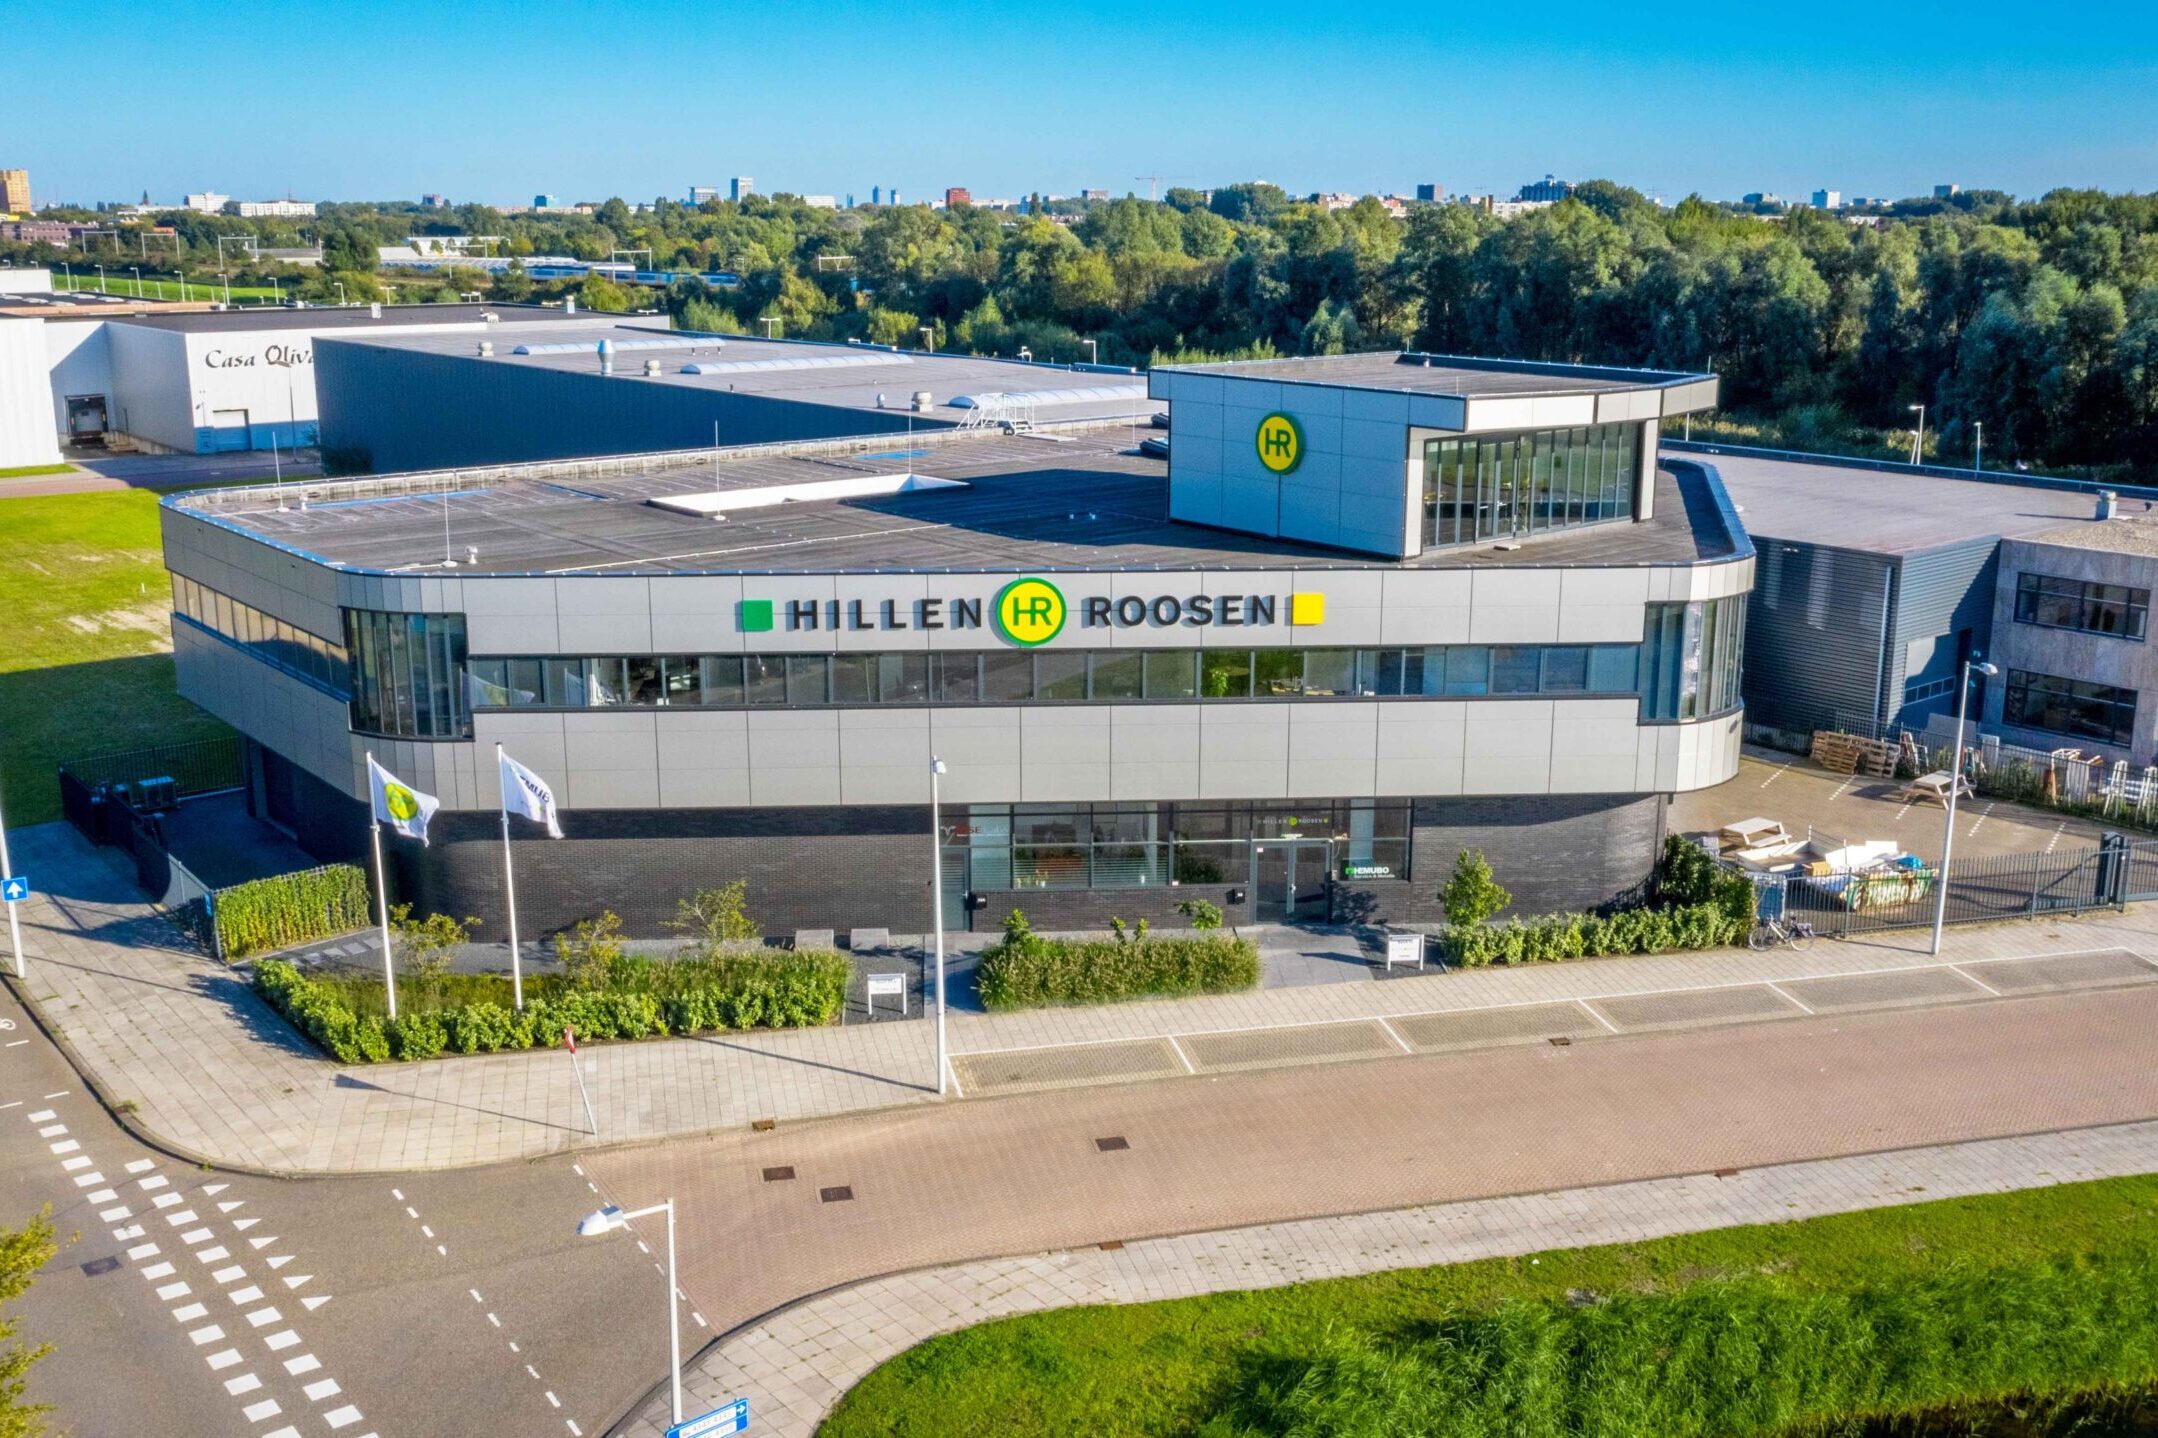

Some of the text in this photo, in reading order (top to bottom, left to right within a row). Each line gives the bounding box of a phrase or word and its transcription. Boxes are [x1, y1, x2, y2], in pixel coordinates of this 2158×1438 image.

[205, 349, 256, 369] Casa
[1264, 427, 1292, 458] HR
[793, 594, 1276, 630] HILLEN HR ROOSEN
